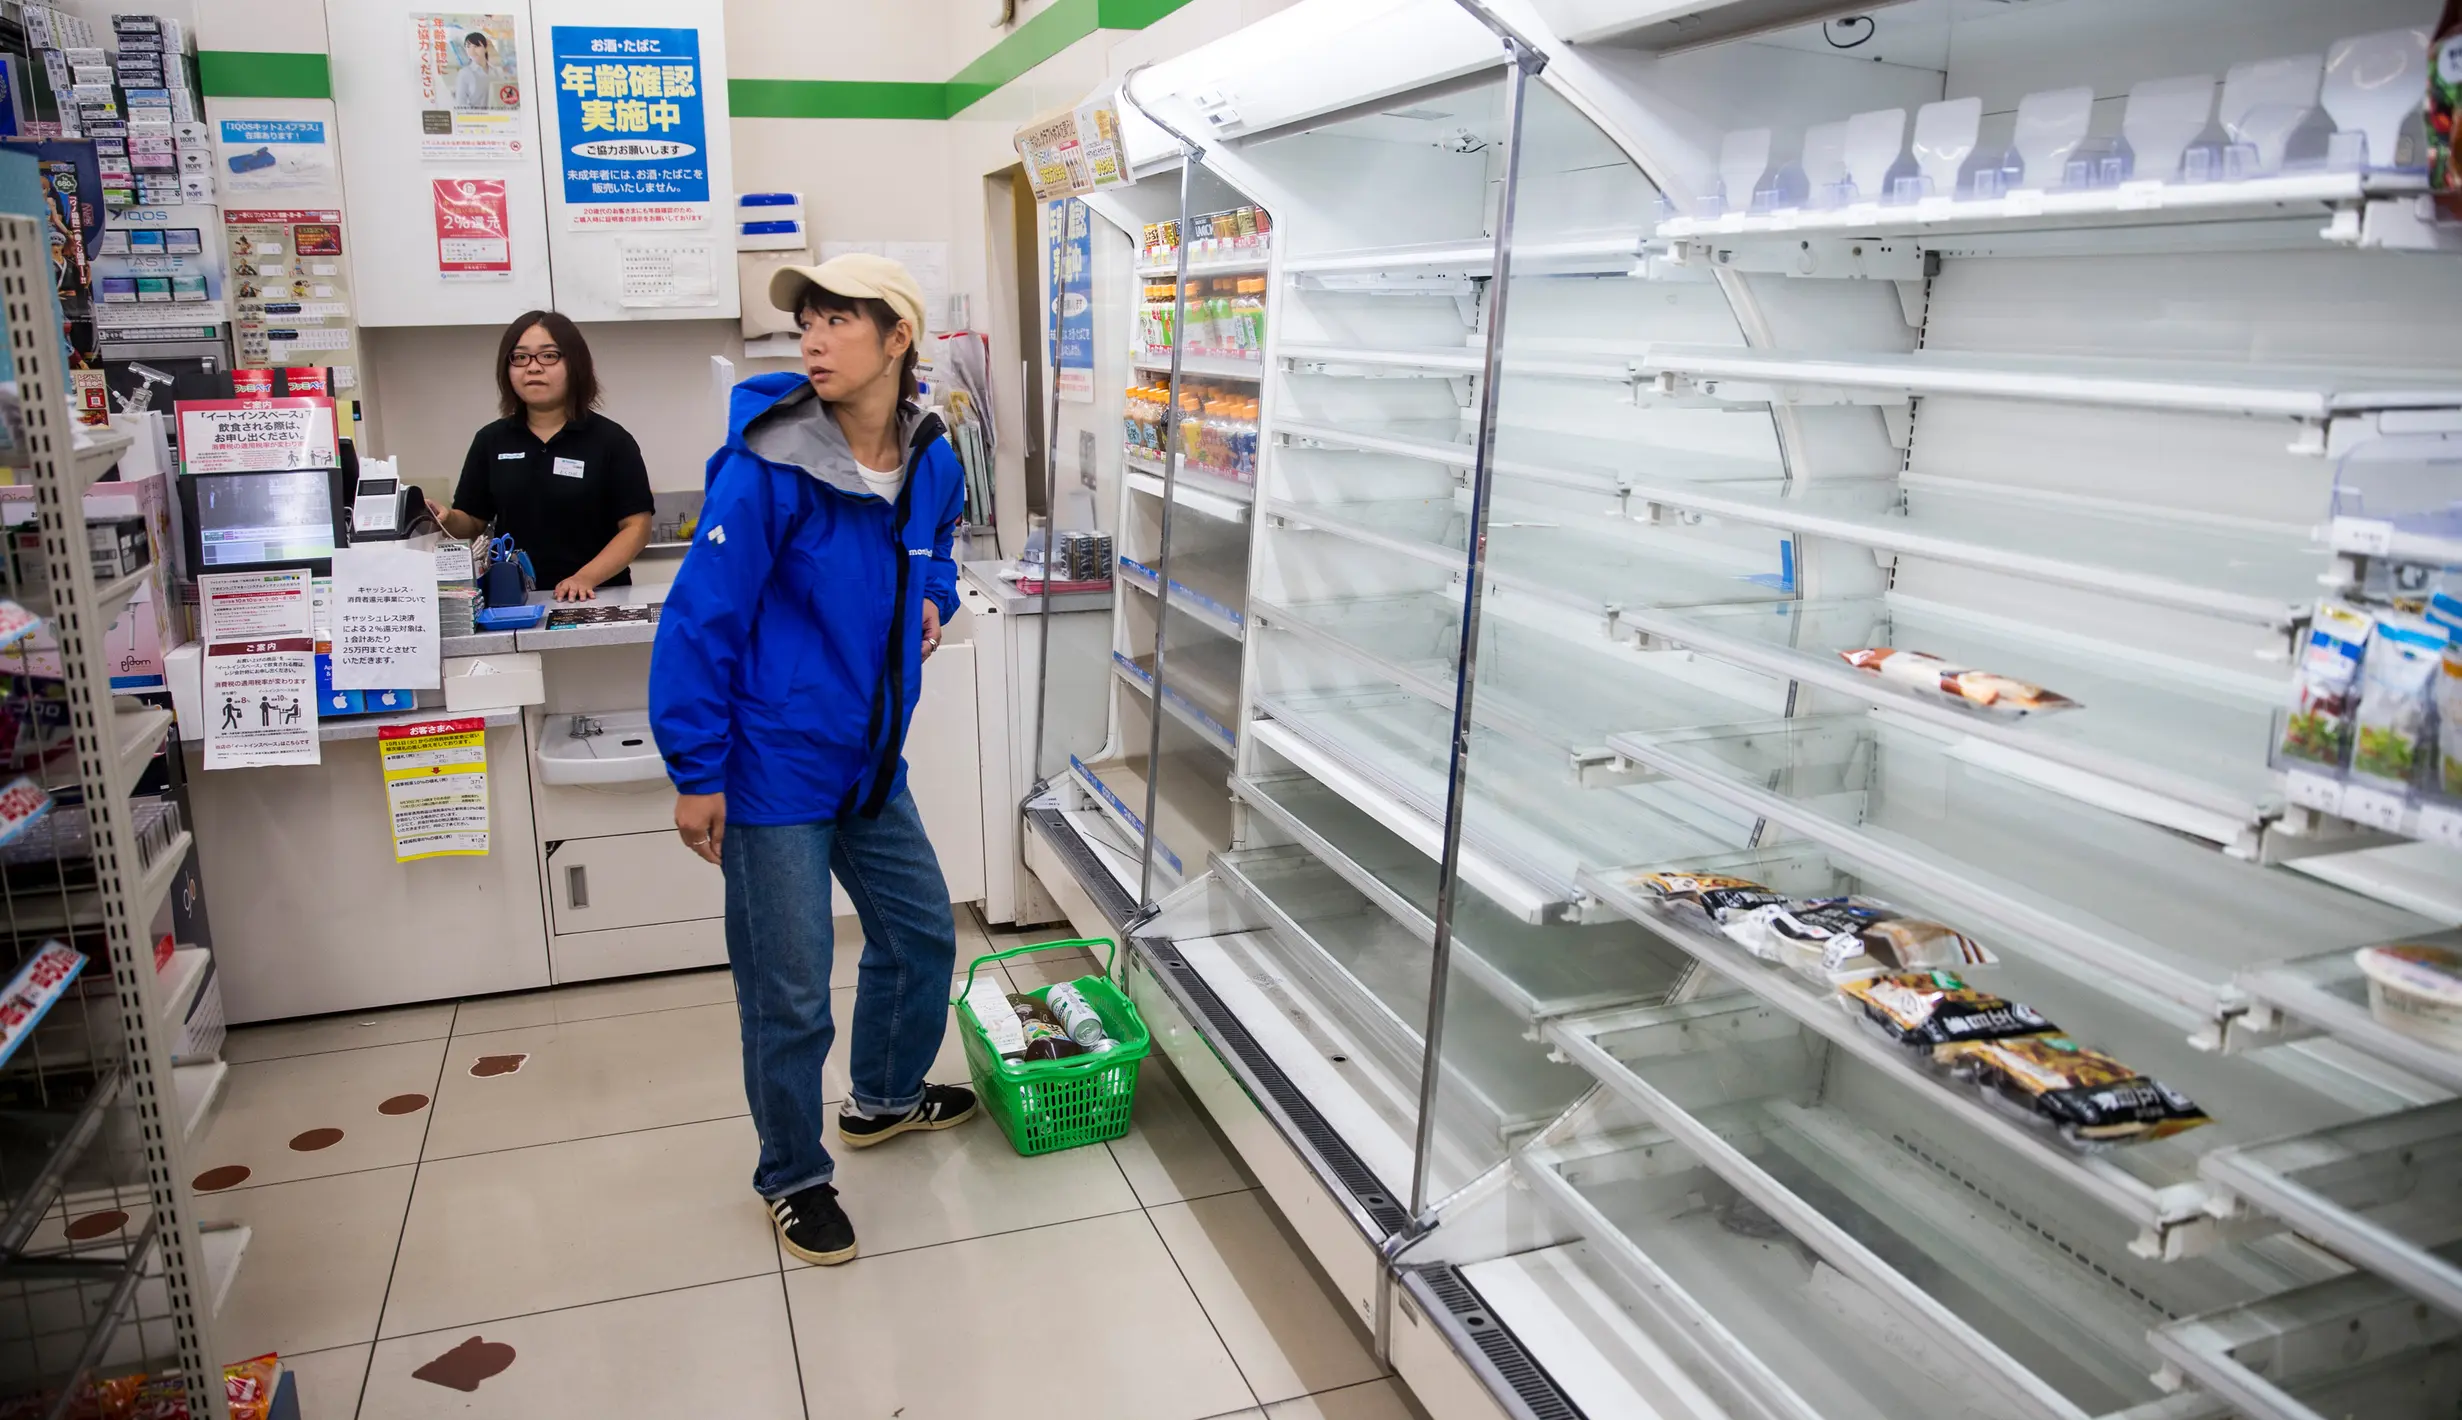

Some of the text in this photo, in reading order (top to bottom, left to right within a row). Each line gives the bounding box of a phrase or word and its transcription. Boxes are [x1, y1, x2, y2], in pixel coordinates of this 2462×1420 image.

[433, 17, 449, 75] 年齢確認に
[560, 63, 696, 98] 年齢確認
[581, 99, 680, 132] 実施中
[587, 145, 680, 155] ご協力お願いします
[567, 169, 703, 181] 未成年者には、お酒・たばこを
[592, 182, 681, 193] 販売いたしません。
[124, 211, 168, 222] IQOS
[121, 256, 183, 267] TASTE
[234, 384, 272, 393] ファミペイ
[288, 381, 326, 391] ファミペイ
[242, 401, 273, 410] ご案内
[218, 421, 301, 433] 飲食される際は、
[214, 432, 305, 443] お申し出ください。
[347, 596, 426, 604] 消費者還元事業について
[343, 614, 415, 622] キャッシュレス決済
[246, 643, 277, 652] ご案内
[343, 646, 417, 654] 25万円までとさせて
[343, 656, 395, 664] いただきます。
[214, 678, 307, 688] 消費税の適用税率が変わります
[410, 725, 455, 736] お客さまへ
